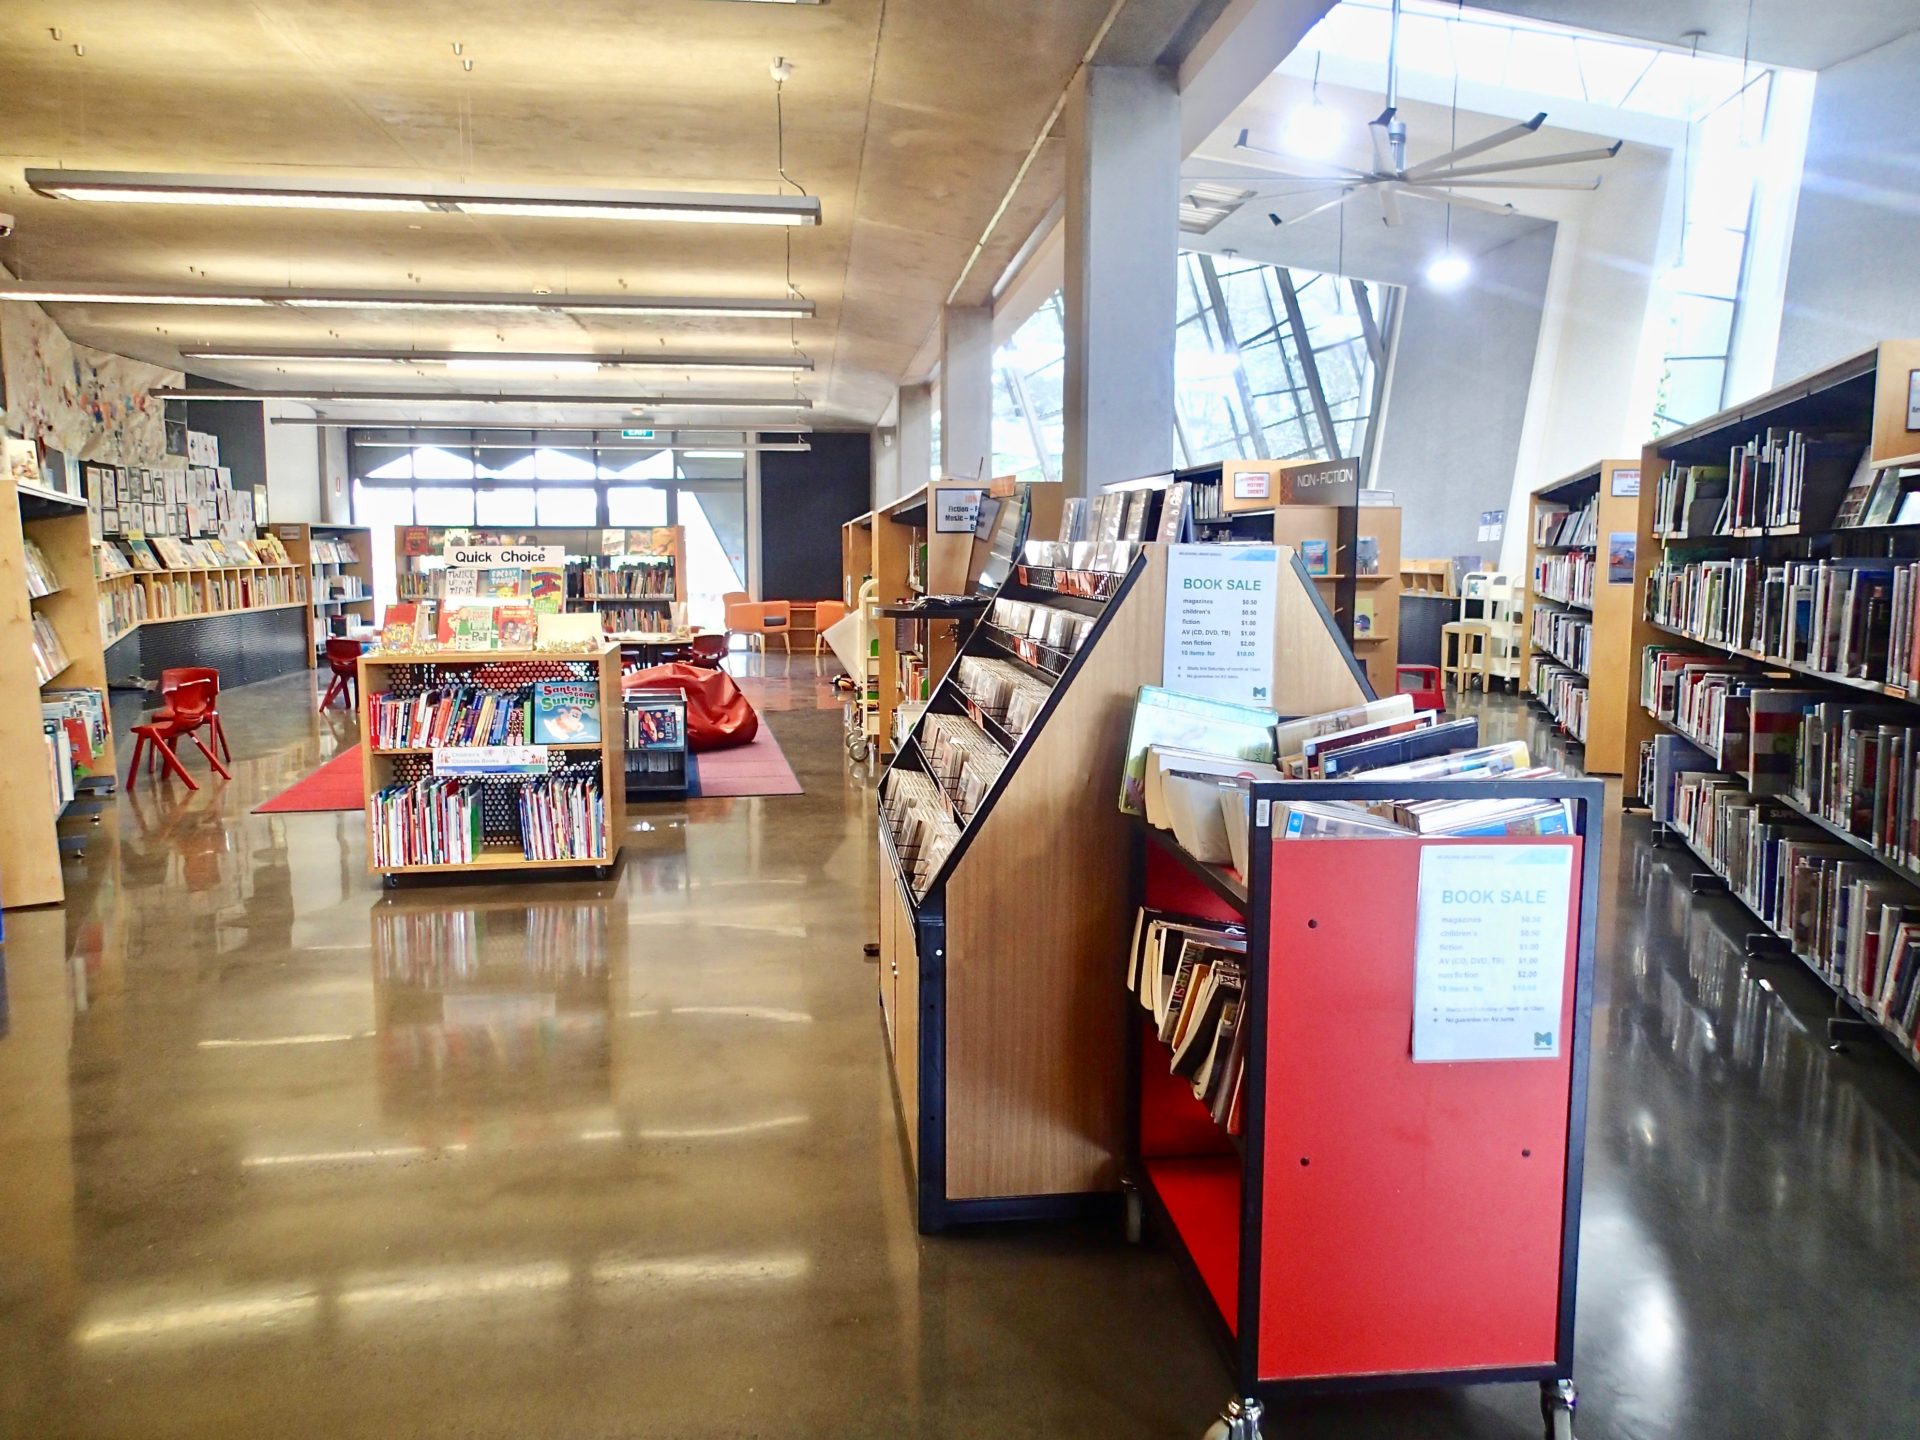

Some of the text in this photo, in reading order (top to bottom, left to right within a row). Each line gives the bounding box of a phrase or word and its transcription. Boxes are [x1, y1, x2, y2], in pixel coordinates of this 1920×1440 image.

[1297, 469, 1353, 487] NON-FICTION
[948, 505, 969, 513] Fiction
[945, 514, 963, 522] Music
[455, 550, 546, 563] Quick Choice
[1183, 578, 1262, 591] BOOK SALE
[541, 696, 596, 710] Surfing
[1441, 889, 1548, 905] BOOK SALE
[1441, 916, 1482, 924] magazines
[1168, 946, 1197, 1013] UNIVERSITY
[1517, 970, 1538, 978] $2.00
